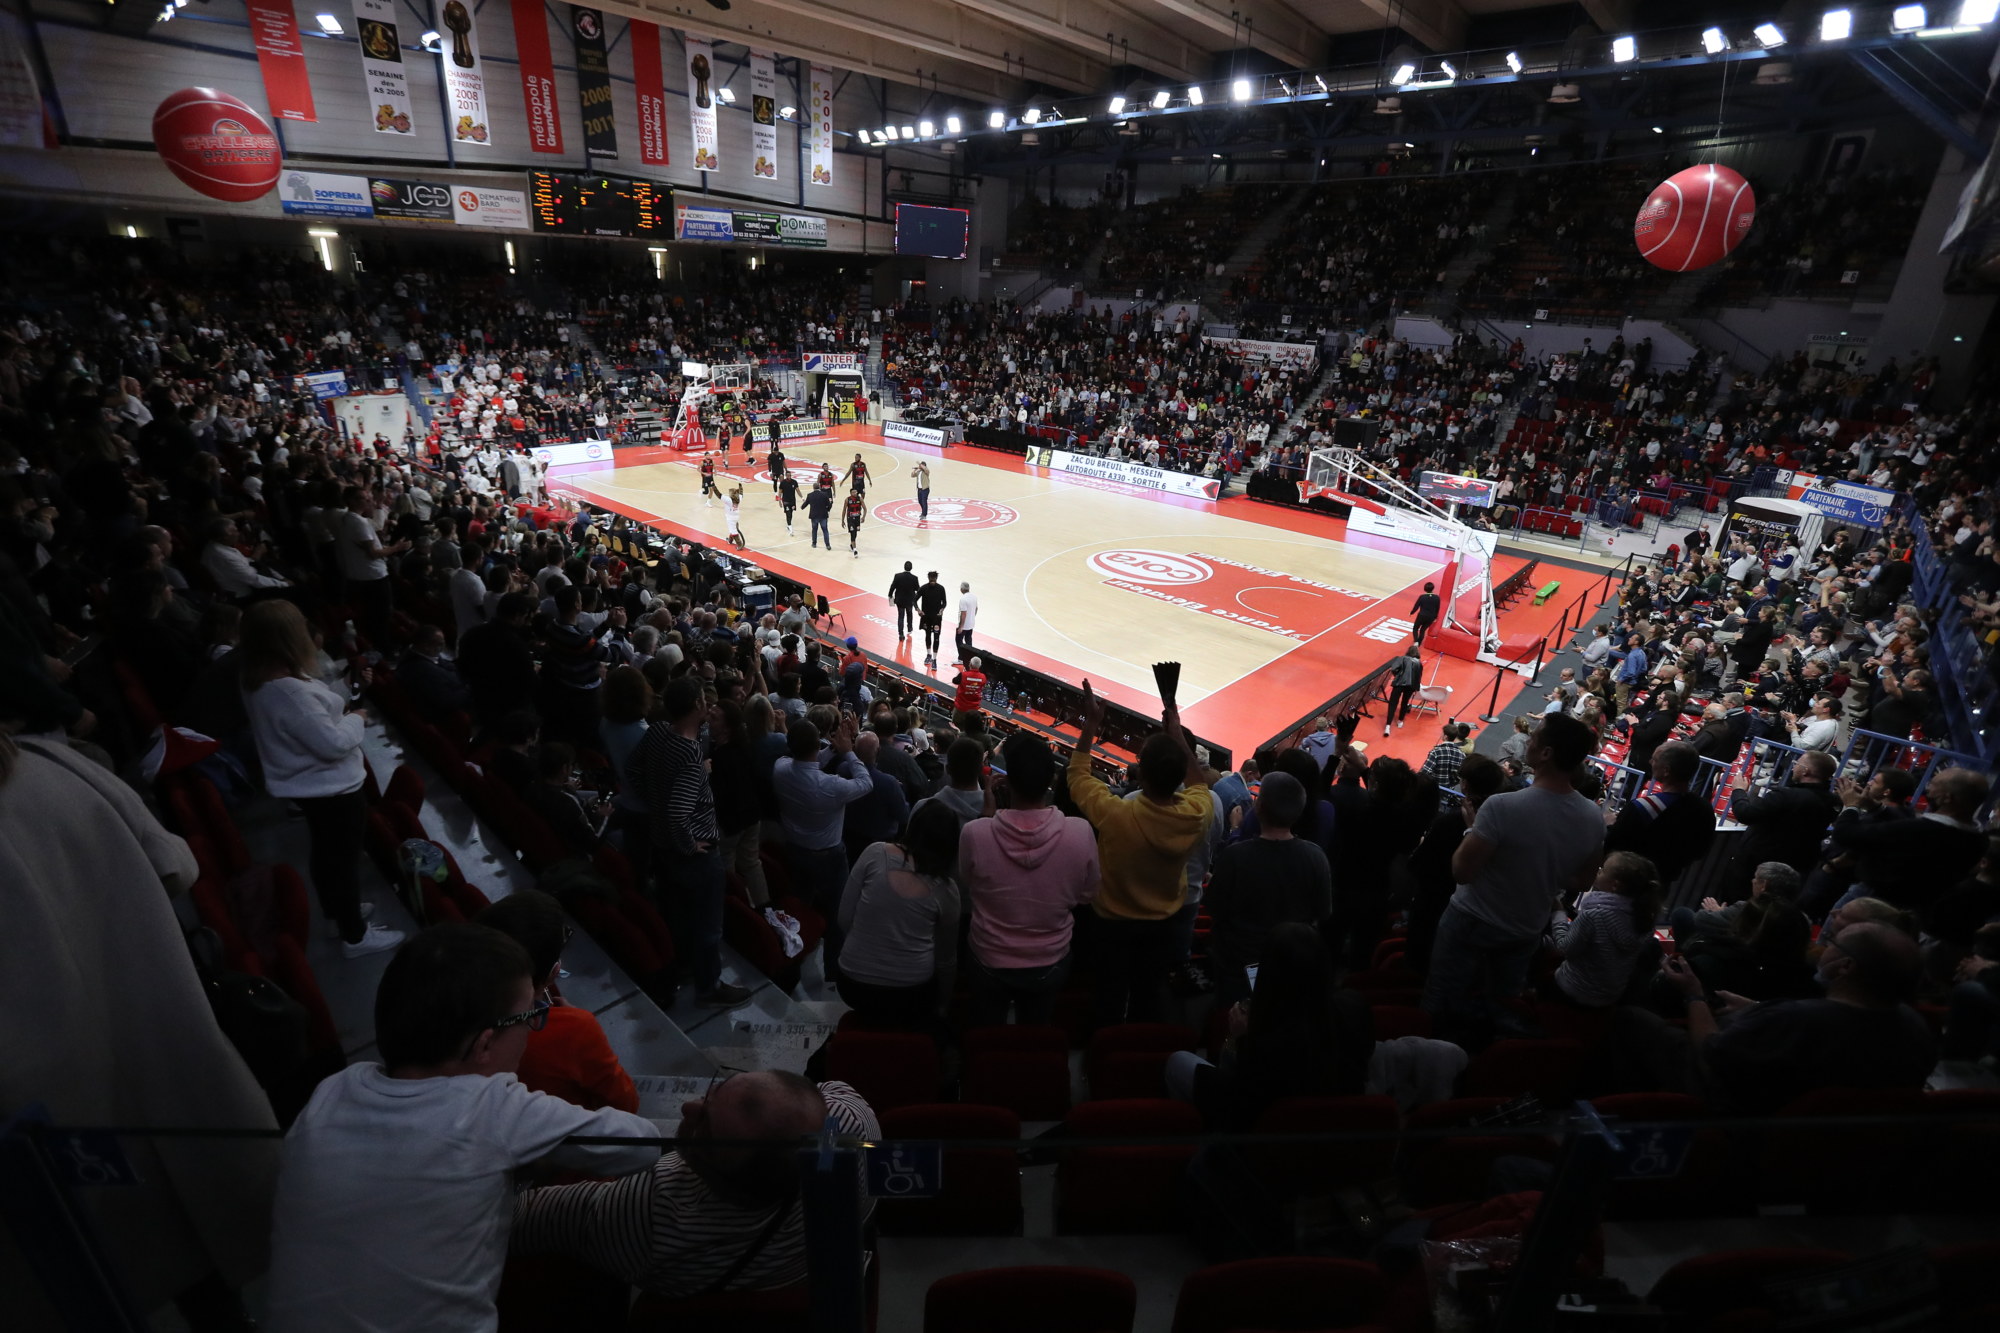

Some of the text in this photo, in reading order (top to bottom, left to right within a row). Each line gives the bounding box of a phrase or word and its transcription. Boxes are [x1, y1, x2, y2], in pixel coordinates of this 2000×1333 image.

[368, 69, 405, 81] SEMAINE
[447, 70, 481, 82] CHAMPION
[449, 79, 482, 91] DE FRANCE
[374, 86, 406, 98] AS 2005
[455, 88, 479, 101] 2008
[580, 86, 612, 107] 2008
[457, 100, 480, 112] 2011
[527, 75, 546, 146] métropole
[541, 77, 557, 147] GrandNancy
[690, 110, 715, 119] CHAMPION
[823, 90, 831, 149] 2002
[584, 115, 615, 137] 2011
[640, 94, 655, 159] métropole
[653, 97, 664, 160] GrandNancy
[696, 125, 713, 136] 2008
[183, 136, 277, 150] CHALLENGE
[697, 135, 713, 145] 2011
[204, 149, 272, 160] BATIGERE
[314, 189, 364, 201] SOPREMA
[401, 184, 451, 208] JCD
[479, 194, 521, 204] DEMATHIEU
[480, 200, 501, 208] BARD
[687, 222, 716, 231] PARTENAIRE
[1812, 335, 1869, 343] BRASSERIE
[1277, 344, 1312, 354] métropole
[822, 355, 853, 363] INTER
[793, 421, 826, 432] MATERIAUX
[886, 423, 915, 434] EUROMAT
[914, 431, 941, 442] Services
[1070, 455, 1083, 464] ZAC
[1085, 457, 1096, 466] DU
[1096, 459, 1123, 472] BREUIL
[1129, 465, 1163, 479] MESSEIN
[1064, 463, 1107, 478] AUTOROUTE
[1107, 471, 1126, 483] A330
[1131, 475, 1160, 488] SORTIE
[1783, 472, 1791, 483] 2
[1807, 492, 1848, 508] PARTENAIRE
[1836, 485, 1879, 503] mutuelles
[1818, 503, 1836, 515] NANCY
[1835, 508, 1857, 519] BASKET
[1107, 553, 1198, 579] cora
[1289, 575, 1366, 598] France
[1213, 609, 1299, 636] France
[775, 1023, 781, 1034] A
[657, 1081, 665, 1092] A
